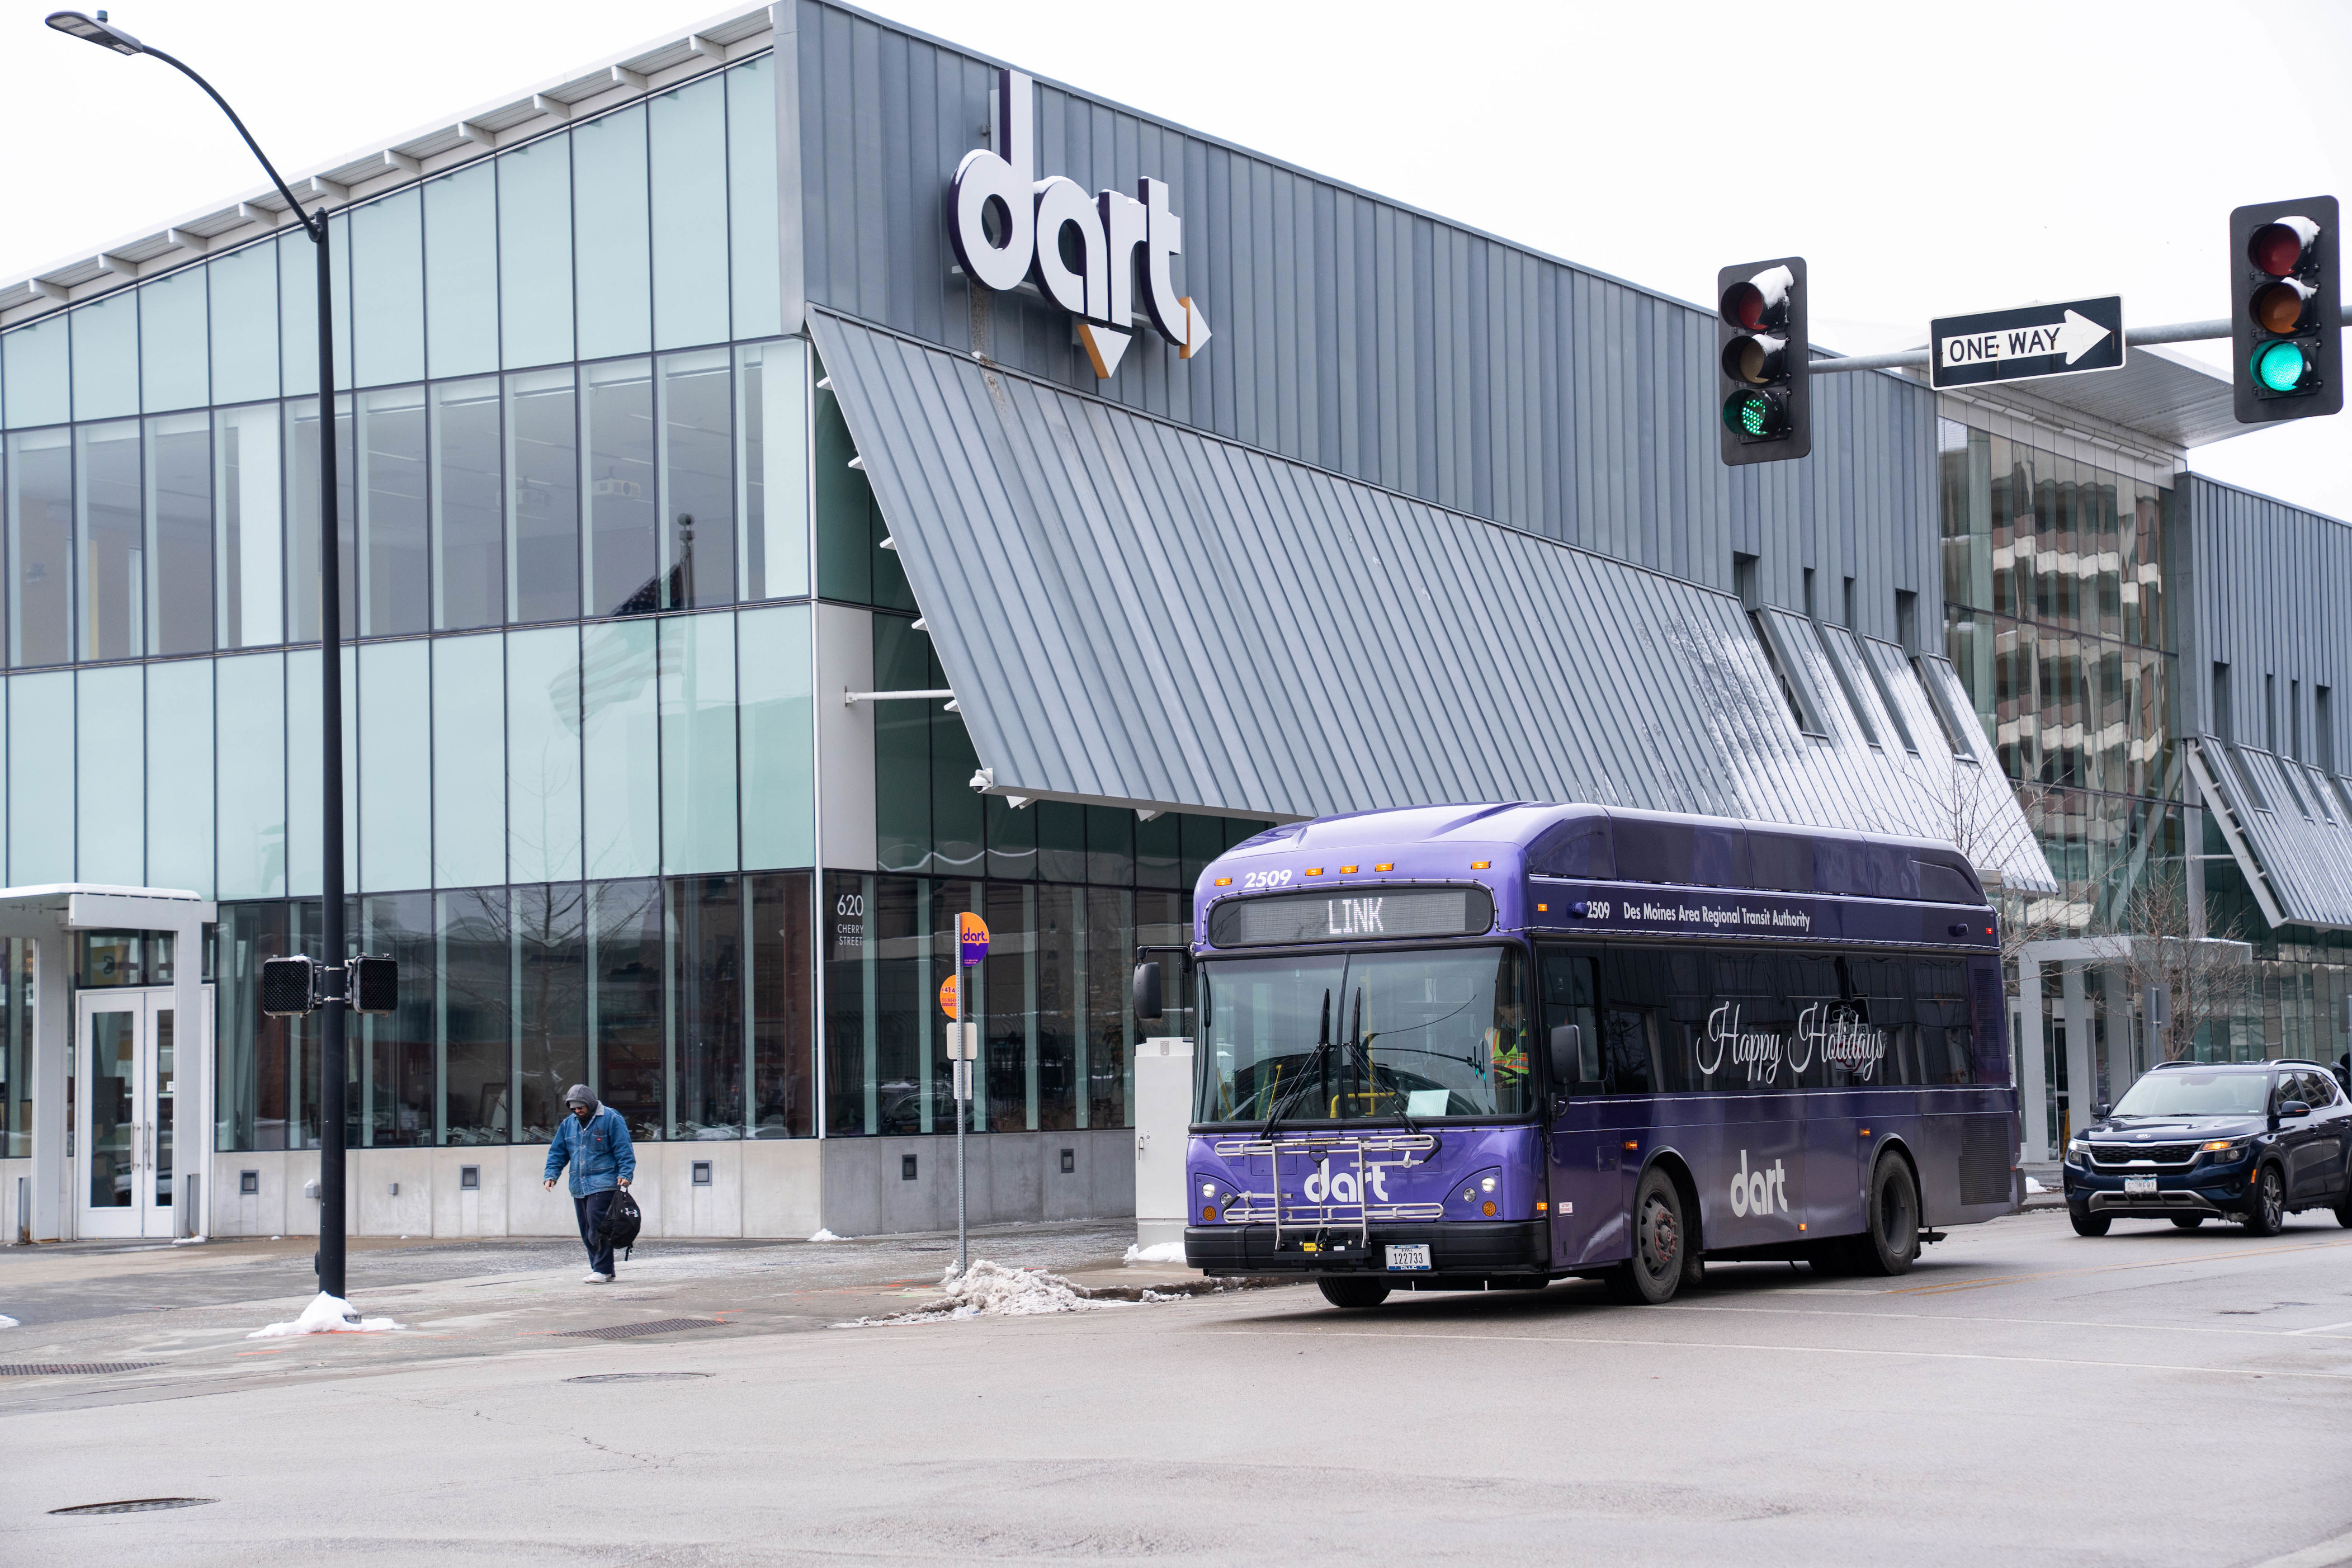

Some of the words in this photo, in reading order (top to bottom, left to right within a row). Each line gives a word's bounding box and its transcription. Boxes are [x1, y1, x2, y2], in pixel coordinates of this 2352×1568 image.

[947, 69, 1189, 346] dart
[1949, 336, 1999, 362] ONE
[2008, 327, 2061, 355] WAY
[1243, 869, 1292, 888] 2509
[837, 894, 864, 917] 620
[1329, 898, 1383, 935] LINK
[1586, 901, 1610, 919] 2509
[1623, 902, 1641, 920] Des
[1643, 902, 1676, 921] Moines
[1679, 905, 1700, 922] Area
[1702, 905, 1740, 928] Regional
[1741, 908, 1770, 925] Transit
[1773, 909, 1810, 932] Authority
[837, 924, 864, 934] CHERRY
[839, 936, 863, 946] STREET
[963, 927, 988, 942] dart
[1696, 1001, 1783, 1084] Happy
[1788, 1002, 1886, 1081] Holidays
[1303, 1158, 1388, 1203] dart
[1730, 1149, 1788, 1218] dart
[1394, 1253, 1423, 1264] 122733
